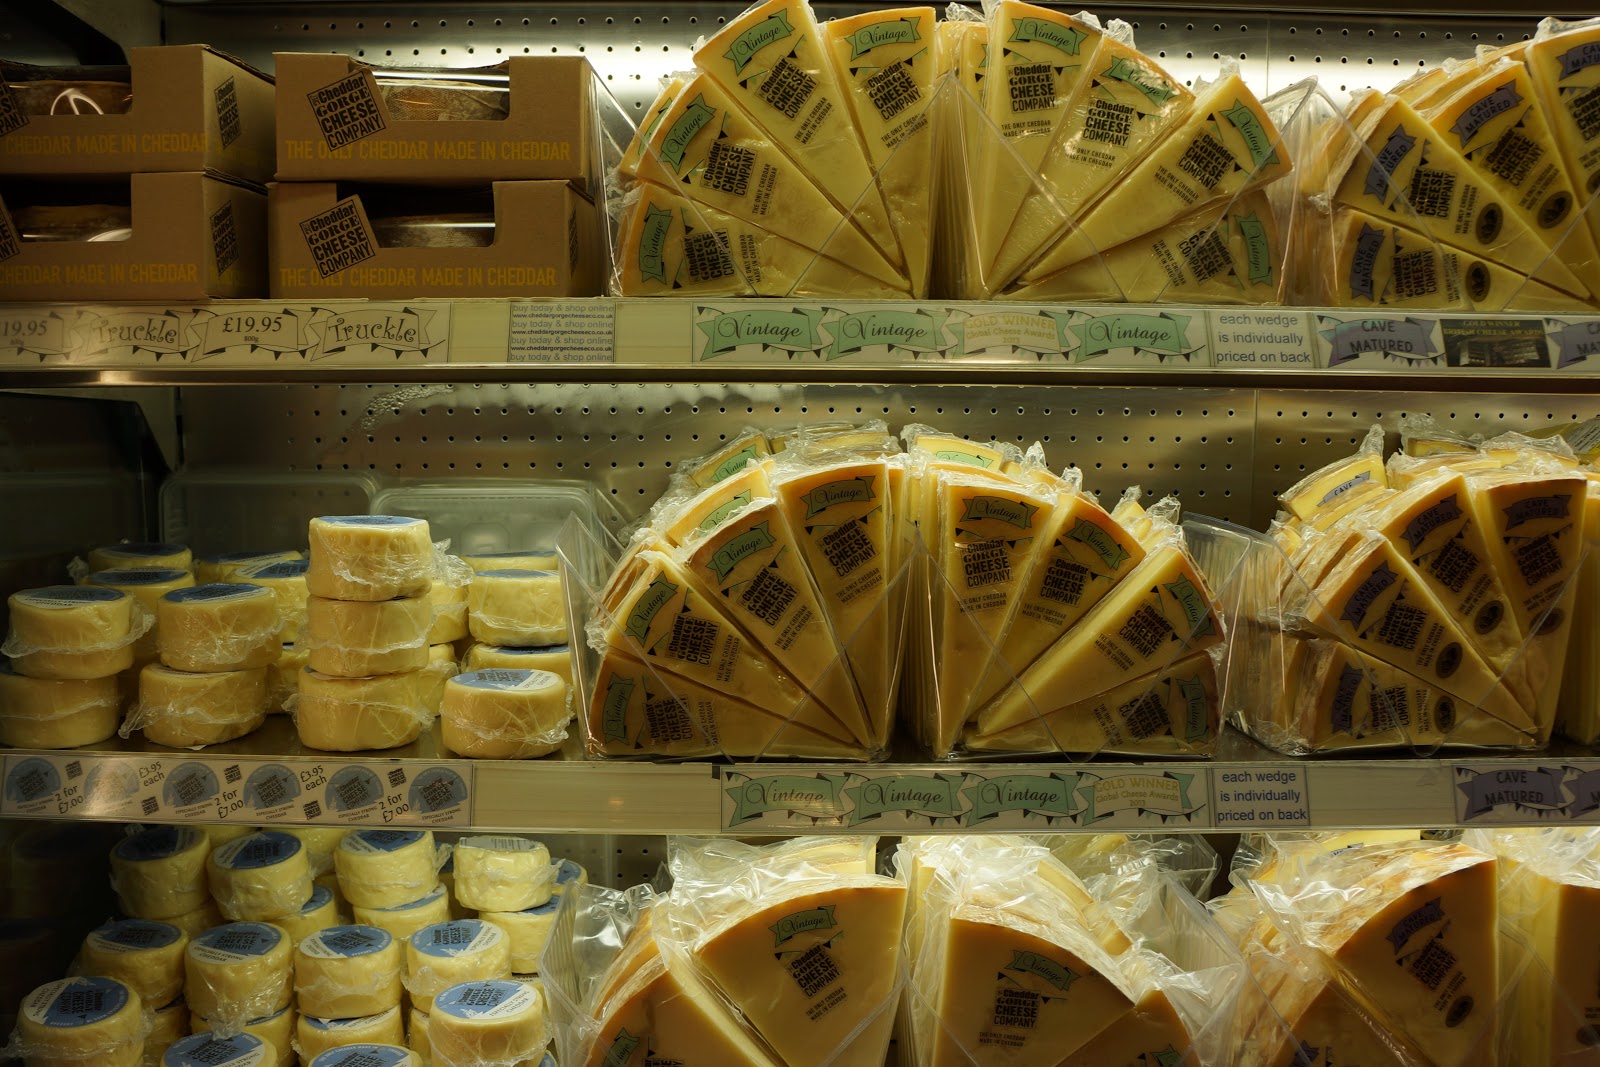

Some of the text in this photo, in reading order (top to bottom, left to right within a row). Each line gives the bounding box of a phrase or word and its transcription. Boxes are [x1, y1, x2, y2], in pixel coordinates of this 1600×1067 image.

[736, 26, 780, 56] Vintage
[859, 26, 909, 46] Vintage
[1024, 21, 1070, 47] Vintage
[761, 58, 788, 93] Cheddar
[1014, 64, 1051, 76] Cheddar
[318, 76, 364, 103] Cheddar
[768, 63, 797, 104] GORGE
[1010, 74, 1053, 86] GORGE
[774, 69, 807, 111] CHEESE
[784, 79, 817, 119] COMPANY
[1011, 84, 1054, 98] CHEESE
[317, 87, 370, 117] GORGE
[1012, 97, 1055, 112] COMPANY
[321, 99, 376, 133] CHEESE
[328, 114, 380, 148] COMPANY
[666, 113, 704, 153] Vintage
[1237, 112, 1264, 156] Vintage
[77, 135, 116, 153] MADE
[120, 134, 136, 152] IN
[142, 133, 208, 152] CHEDDAR
[286, 141, 313, 160] THE
[360, 141, 429, 160] CHEDDAR
[433, 141, 477, 160] MADE
[481, 141, 496, 160] IN
[501, 141, 571, 160] CHEDDAR
[704, 142, 722, 180] Cheddar
[713, 144, 731, 189] GORGE
[722, 146, 744, 193] CHEESE
[734, 150, 755, 196] COMPANY
[310, 204, 354, 232] Cheddar
[308, 215, 360, 245] GORGE
[313, 227, 366, 261] CHEESE
[320, 242, 370, 275] COMPANY
[66, 264, 105, 284] MADE
[110, 264, 124, 283] IN
[130, 264, 197, 283] CHEDDAR
[280, 268, 305, 287] THE
[351, 268, 415, 287] CHEDDAR
[421, 268, 463, 287] MADE
[468, 268, 482, 287] IN
[486, 268, 556, 287] CHEDDAR
[513, 304, 528, 314] buy
[531, 305, 553, 314] today
[566, 306, 586, 314] shop
[223, 316, 282, 333] £19.95
[328, 317, 417, 343] Truckle
[530, 321, 552, 330] today
[565, 321, 585, 329] shop
[718, 314, 803, 342] Vintage
[843, 315, 927, 342] Vintage
[965, 315, 1055, 329] GOLD WINNER
[1220, 314, 1298, 327] each wedge
[1362, 321, 1395, 333] CAVE
[99, 317, 177, 344] Truckle
[966, 330, 990, 339] Global
[1024, 329, 1055, 339] Awards
[1089, 317, 1172, 345] Vintage
[1219, 332, 1303, 346] is individually
[512, 337, 526, 345] buy
[529, 337, 551, 346] today
[564, 337, 584, 345] shop
[1350, 339, 1413, 353] MATURED
[511, 353, 526, 361] buy
[563, 354, 583, 362] shop
[1217, 351, 1311, 364] priced on back
[815, 486, 864, 503] Vintage
[976, 501, 1022, 520] Vintage
[823, 519, 857, 545] Cheddar
[824, 526, 864, 555] GORGE
[719, 537, 763, 564] Vintage
[829, 536, 870, 567] CHEESE
[1081, 525, 1113, 559] Vintage
[836, 546, 877, 577] COMPANY
[139, 762, 161, 778] £3.95
[144, 771, 165, 786] each
[301, 765, 323, 782] £3.95
[1223, 772, 1296, 784] each wedge
[1496, 772, 1527, 783] CAVE
[64, 786, 78, 797] for
[305, 776, 327, 790] each
[1094, 777, 1179, 792] GOLD WINNER
[223, 790, 237, 801] for
[379, 794, 402, 810] 2 for
[746, 780, 826, 807] Vintage
[864, 780, 944, 807] Vintage
[981, 780, 1060, 807] Vintage
[1096, 790, 1178, 803] Global Cheese Awards
[1221, 790, 1300, 803] is individually
[1485, 791, 1543, 805] MATURED
[59, 796, 83, 814] £7.00
[218, 800, 243, 818] £7.00
[383, 804, 409, 823] £7.00
[1218, 809, 1307, 823] priced on back
[782, 916, 825, 932] Vintage
[791, 945, 822, 970] Cheddar
[793, 952, 828, 979] GORGE
[798, 958, 834, 988] CHEESE
[1023, 956, 1062, 982] Vintage
[804, 967, 840, 997] COMPANY
[997, 997, 1039, 1007] GORGE
[1003, 990, 1039, 999] Cheddar
[996, 1005, 1037, 1017] CHEESE
[994, 1016, 1035, 1028] COMPANY
